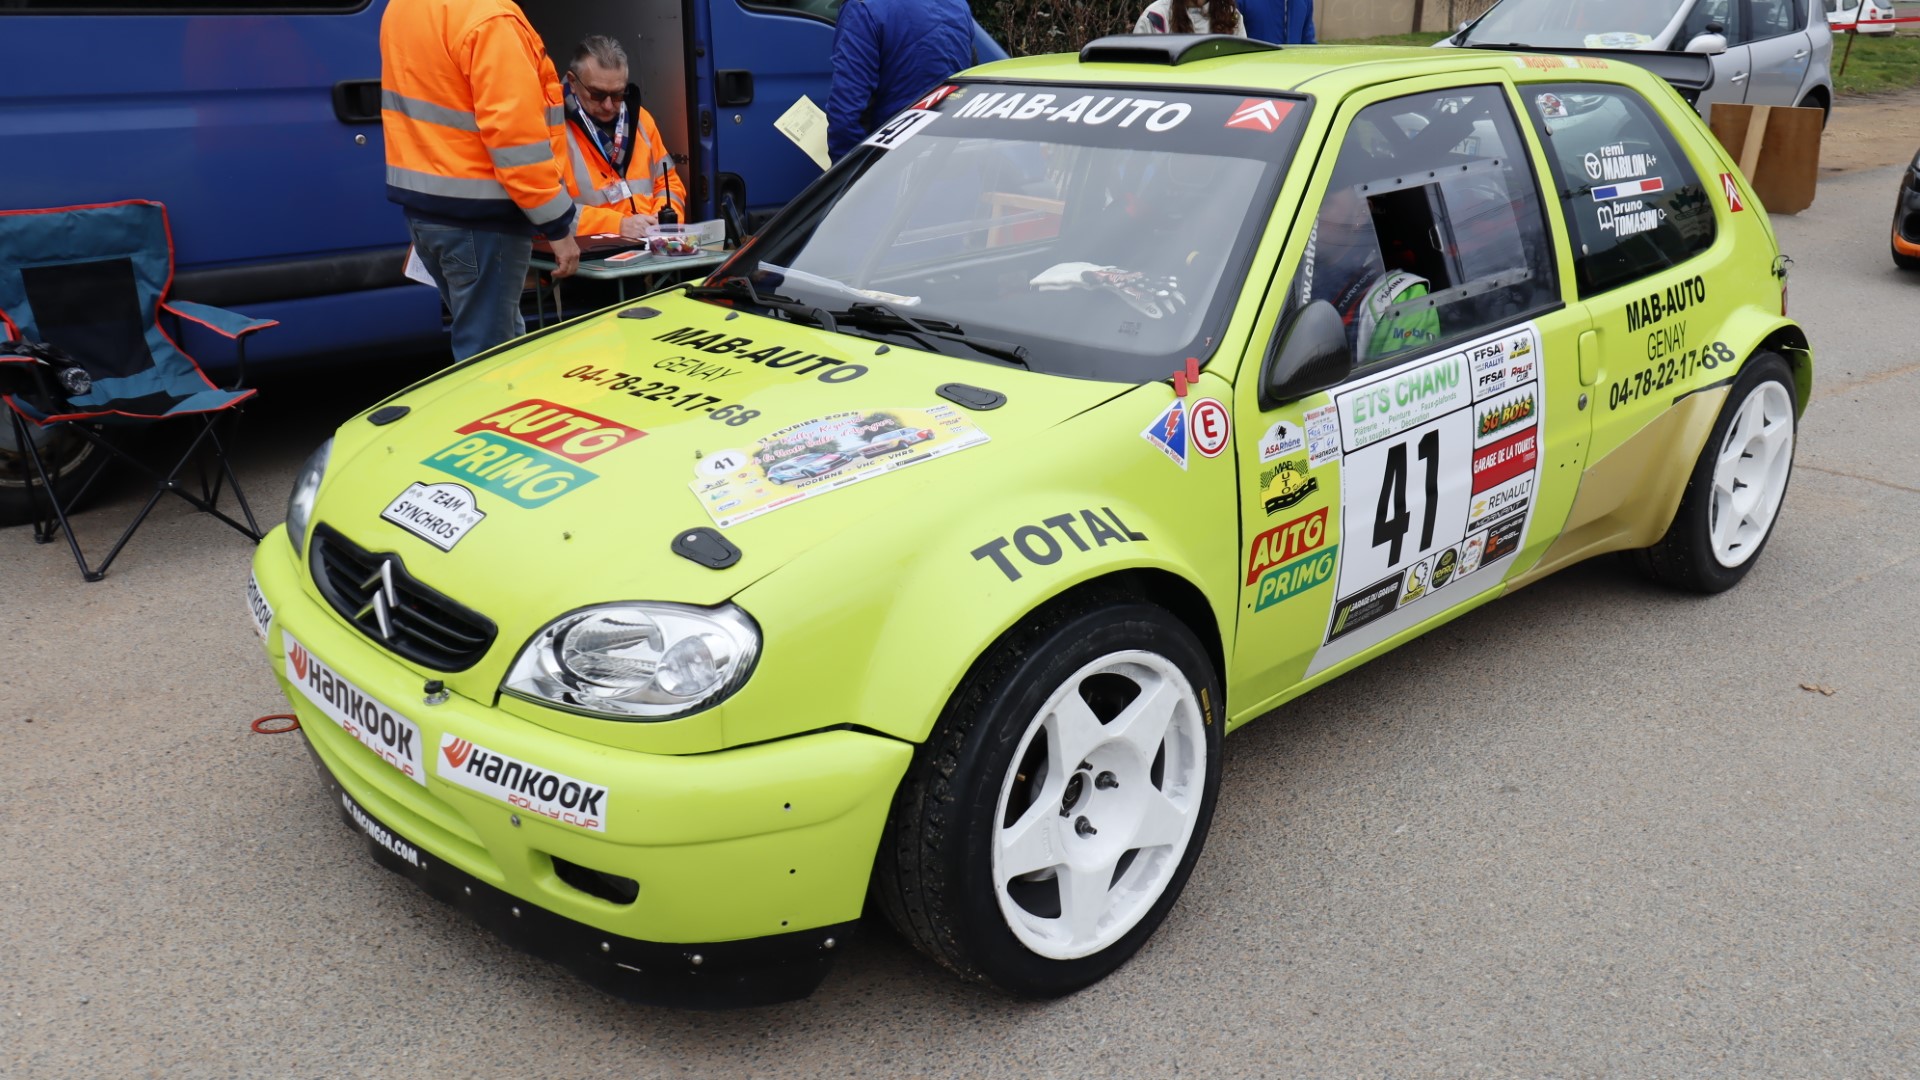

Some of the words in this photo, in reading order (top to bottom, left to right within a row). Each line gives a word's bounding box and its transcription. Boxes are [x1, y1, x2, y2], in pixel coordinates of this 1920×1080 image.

[875, 112, 927, 144] 41
[952, 92, 1192, 132] MAB-AUTO
[1601, 141, 1624, 157] remi
[1602, 154, 1646, 180] MABILON
[1646, 153, 1657, 167] A+
[1613, 200, 1643, 215] bruno
[1614, 209, 1657, 237] TOMASINI
[1626, 275, 1705, 333] MAB-AUTO
[1392, 327, 1424, 340] Mobil
[1647, 320, 1687, 361] GENAY
[651, 326, 869, 384] MAB-AUTO
[653, 356, 742, 382] GENAY
[1484, 356, 1504, 369] RALLYE
[1352, 384, 1391, 424] ETS
[1395, 358, 1460, 407] CHANU
[1609, 341, 1736, 411] 04-78-22-17-68
[562, 364, 761, 427] 04-78-22-17-68
[480, 404, 626, 454] AUTO
[772, 418, 819, 437] FEVRIER
[1201, 408, 1218, 438] E
[1482, 411, 1500, 433] SG
[1501, 398, 1532, 426] BOIS
[434, 437, 576, 500] PRIMO
[714, 457, 735, 470] 41
[797, 470, 843, 489] MODERNE
[888, 448, 914, 459] VHRS
[1474, 452, 1497, 474] GARAGE
[1497, 448, 1506, 464] DE
[1506, 445, 1514, 460] LA
[428, 489, 467, 512] TEAM
[1372, 428, 1439, 568] 41
[1488, 479, 1531, 510] RENAULT
[393, 500, 460, 539] SYNCHROS
[970, 506, 1150, 582] TOTAL
[1251, 515, 1323, 572] AUTO
[1259, 552, 1332, 605] PRIMO
[563, 812, 599, 829] CUP
